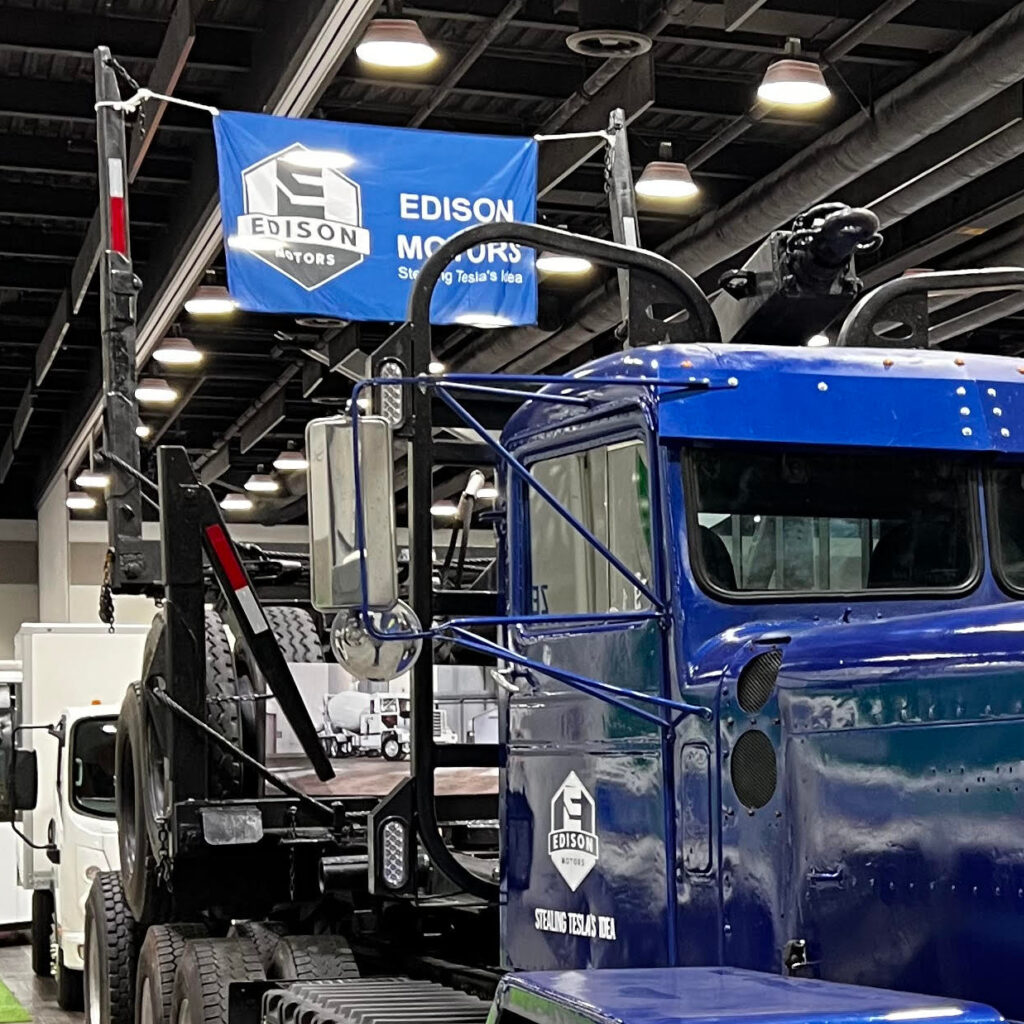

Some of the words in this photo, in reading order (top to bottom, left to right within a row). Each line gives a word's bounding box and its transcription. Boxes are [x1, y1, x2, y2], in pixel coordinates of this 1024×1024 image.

[400, 193, 514, 222] EDISON
[251, 217, 357, 247] EDISON
[397, 234, 522, 264] MOORS
[552, 831, 594, 853] EDISON
[534, 907, 567, 934] STEALING
[567, 912, 597, 938] TESLA'S
[598, 916, 617, 940] IDEA
